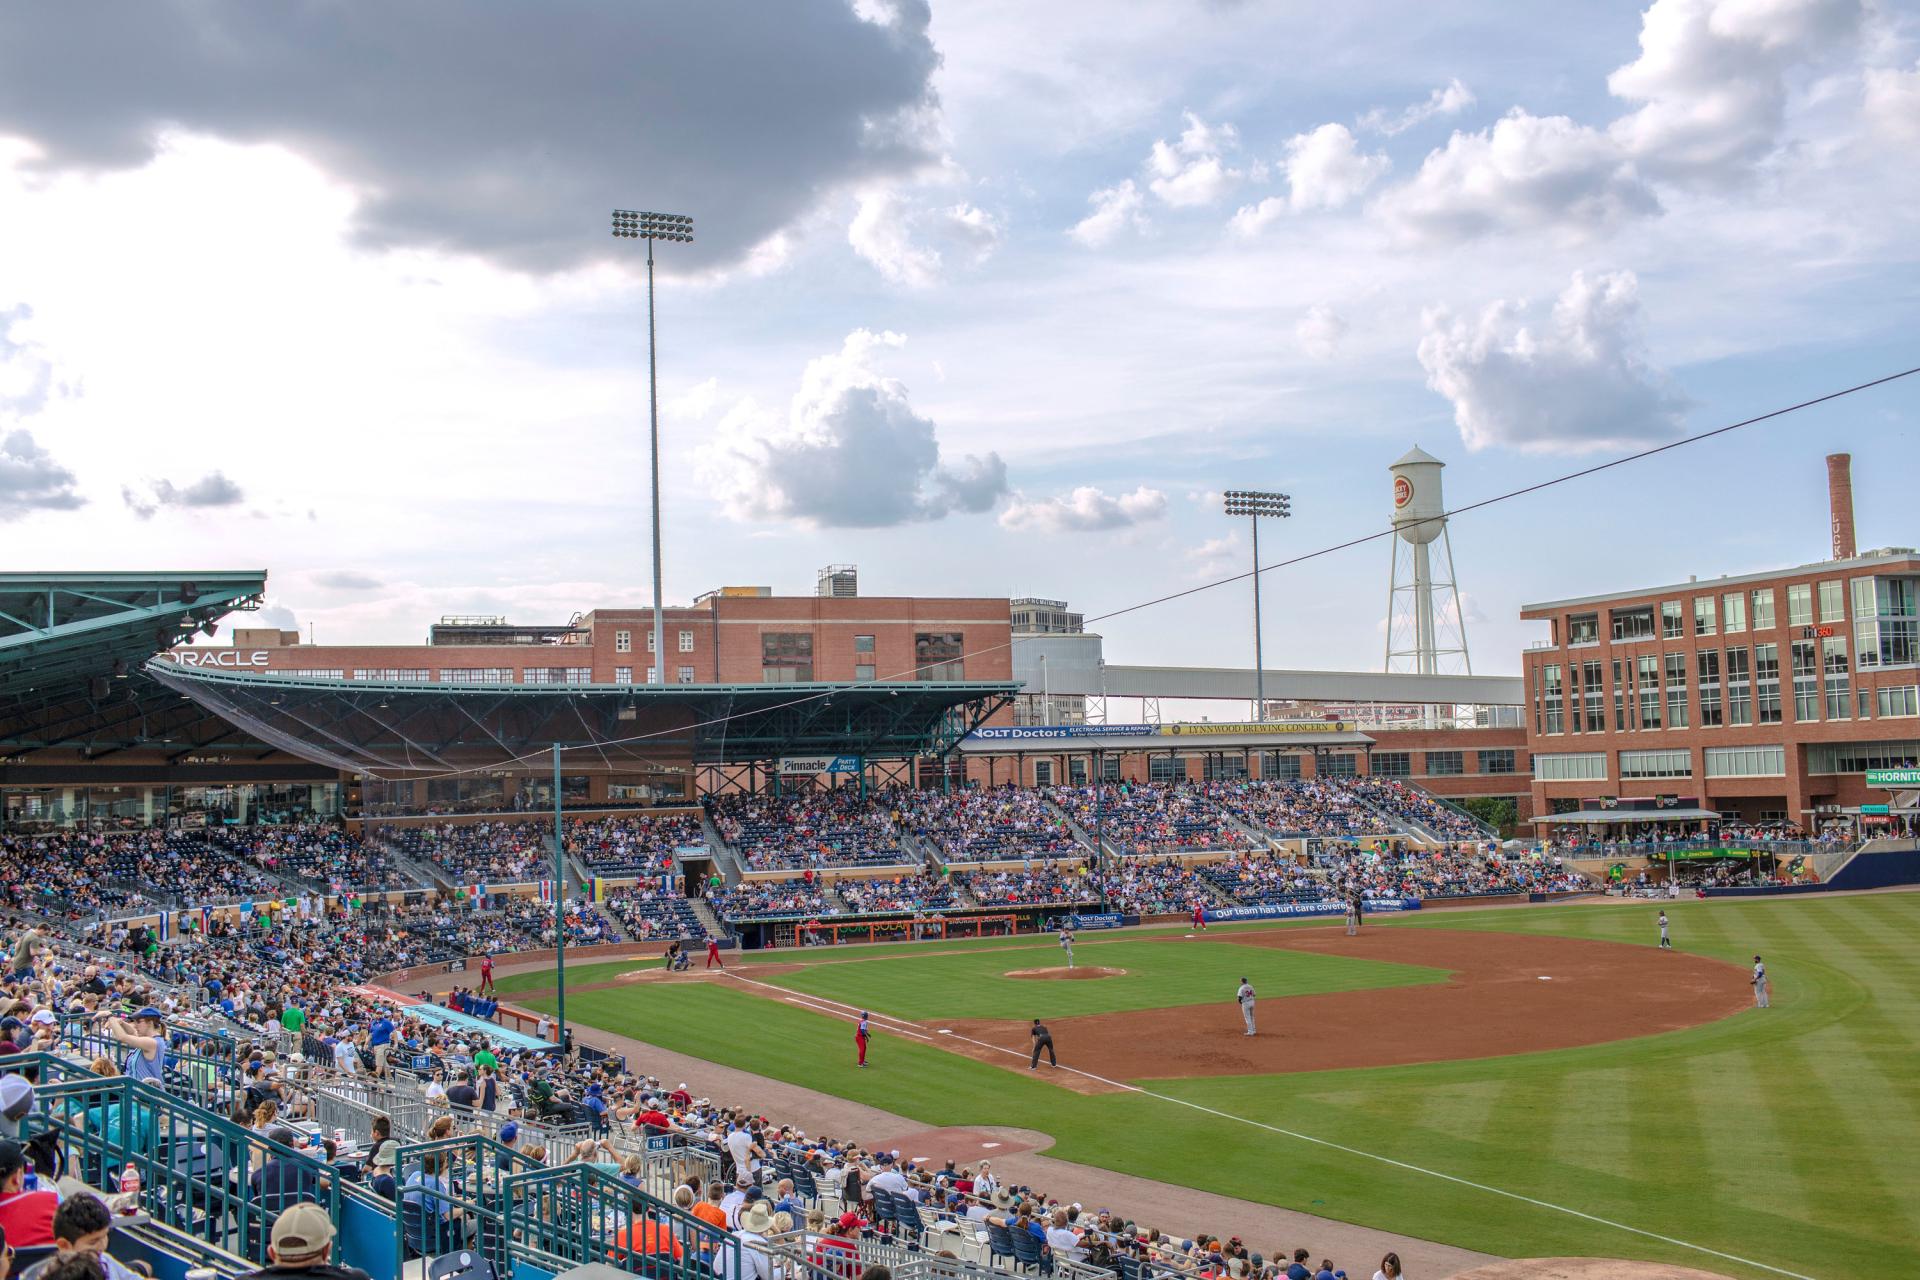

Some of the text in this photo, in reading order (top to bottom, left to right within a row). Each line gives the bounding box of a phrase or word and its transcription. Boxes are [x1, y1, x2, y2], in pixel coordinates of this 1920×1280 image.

[972, 728, 1066, 738] VOLT Doctors
[1189, 722, 1328, 734] LYNNWOOD BREWING CONCERN
[784, 760, 826, 771] Pinnacle
[1216, 900, 1346, 918] Our team has turf care covere
[651, 1140, 665, 1148] 116
